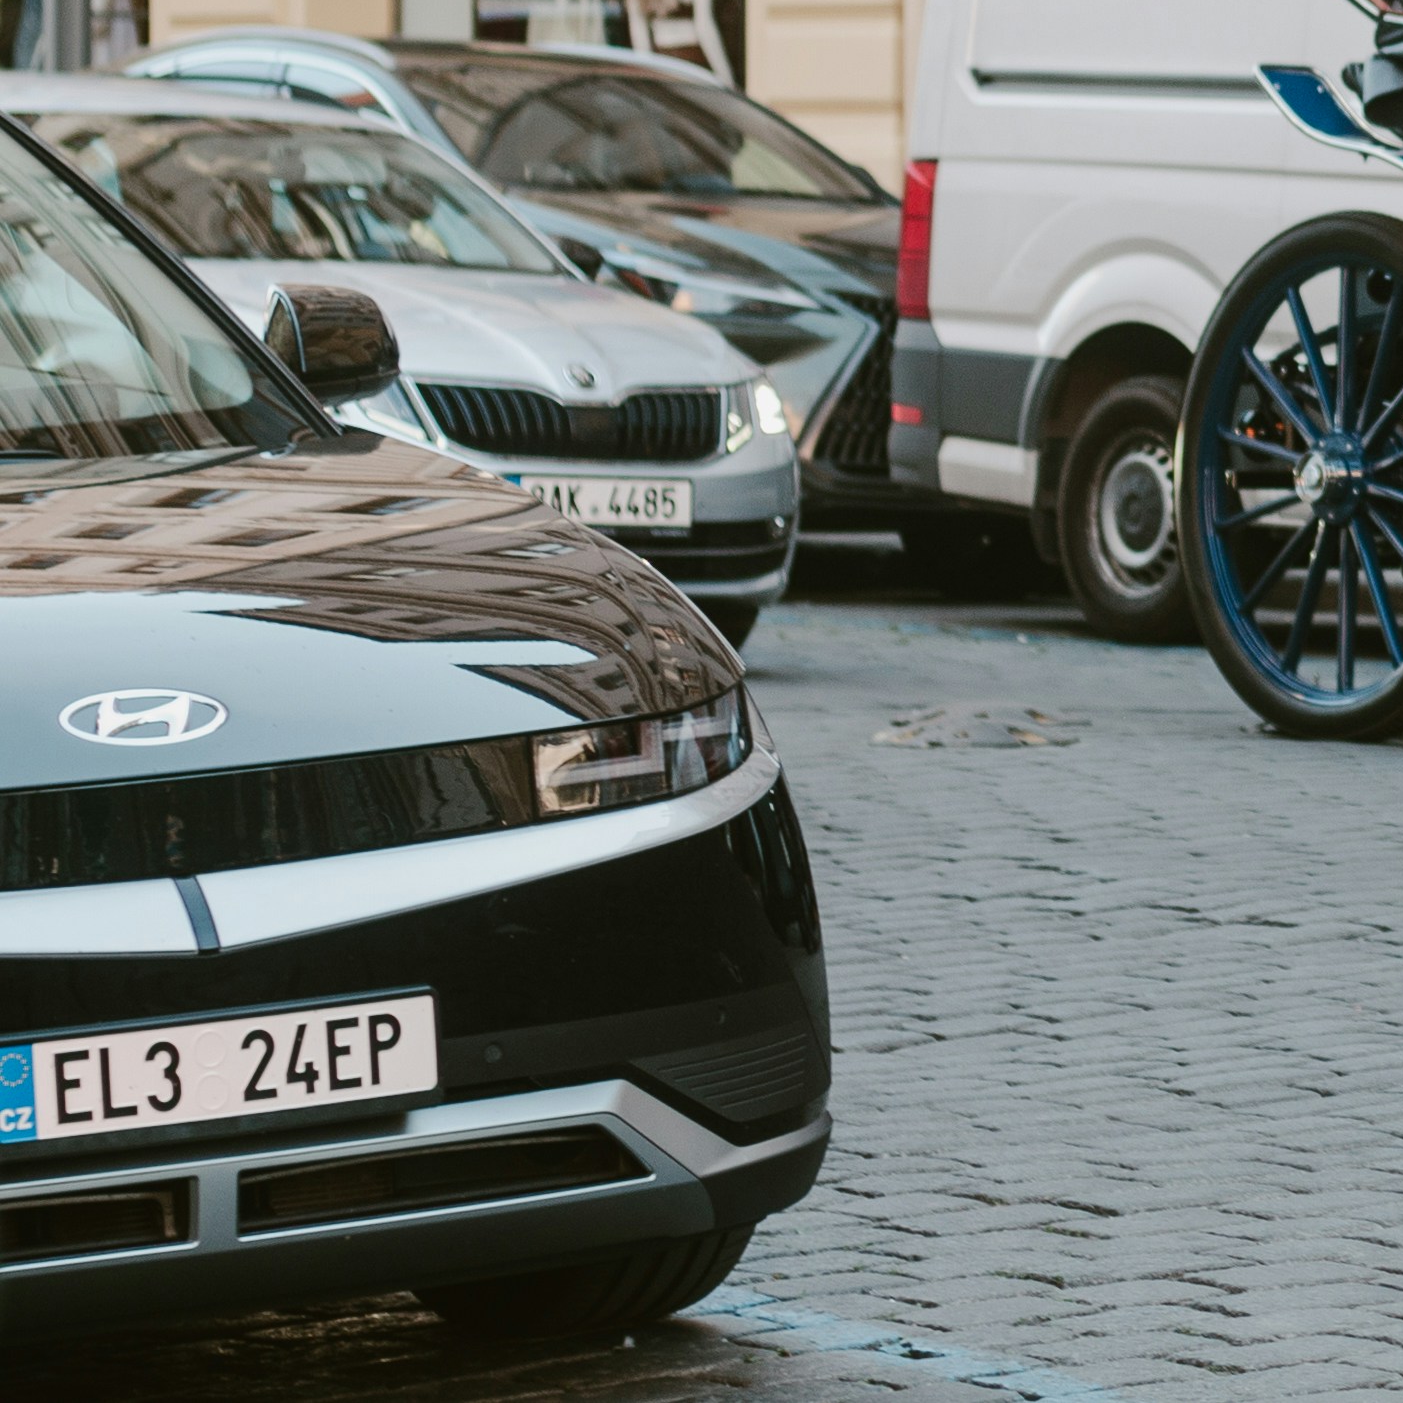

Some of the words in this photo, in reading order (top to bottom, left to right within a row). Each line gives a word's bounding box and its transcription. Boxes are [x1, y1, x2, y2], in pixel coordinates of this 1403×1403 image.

[609, 485, 676, 518] 4485
[0, 1106, 33, 1132] CZ
[54, 1041, 182, 1125] EL3
[240, 1013, 401, 1102] 24EP
